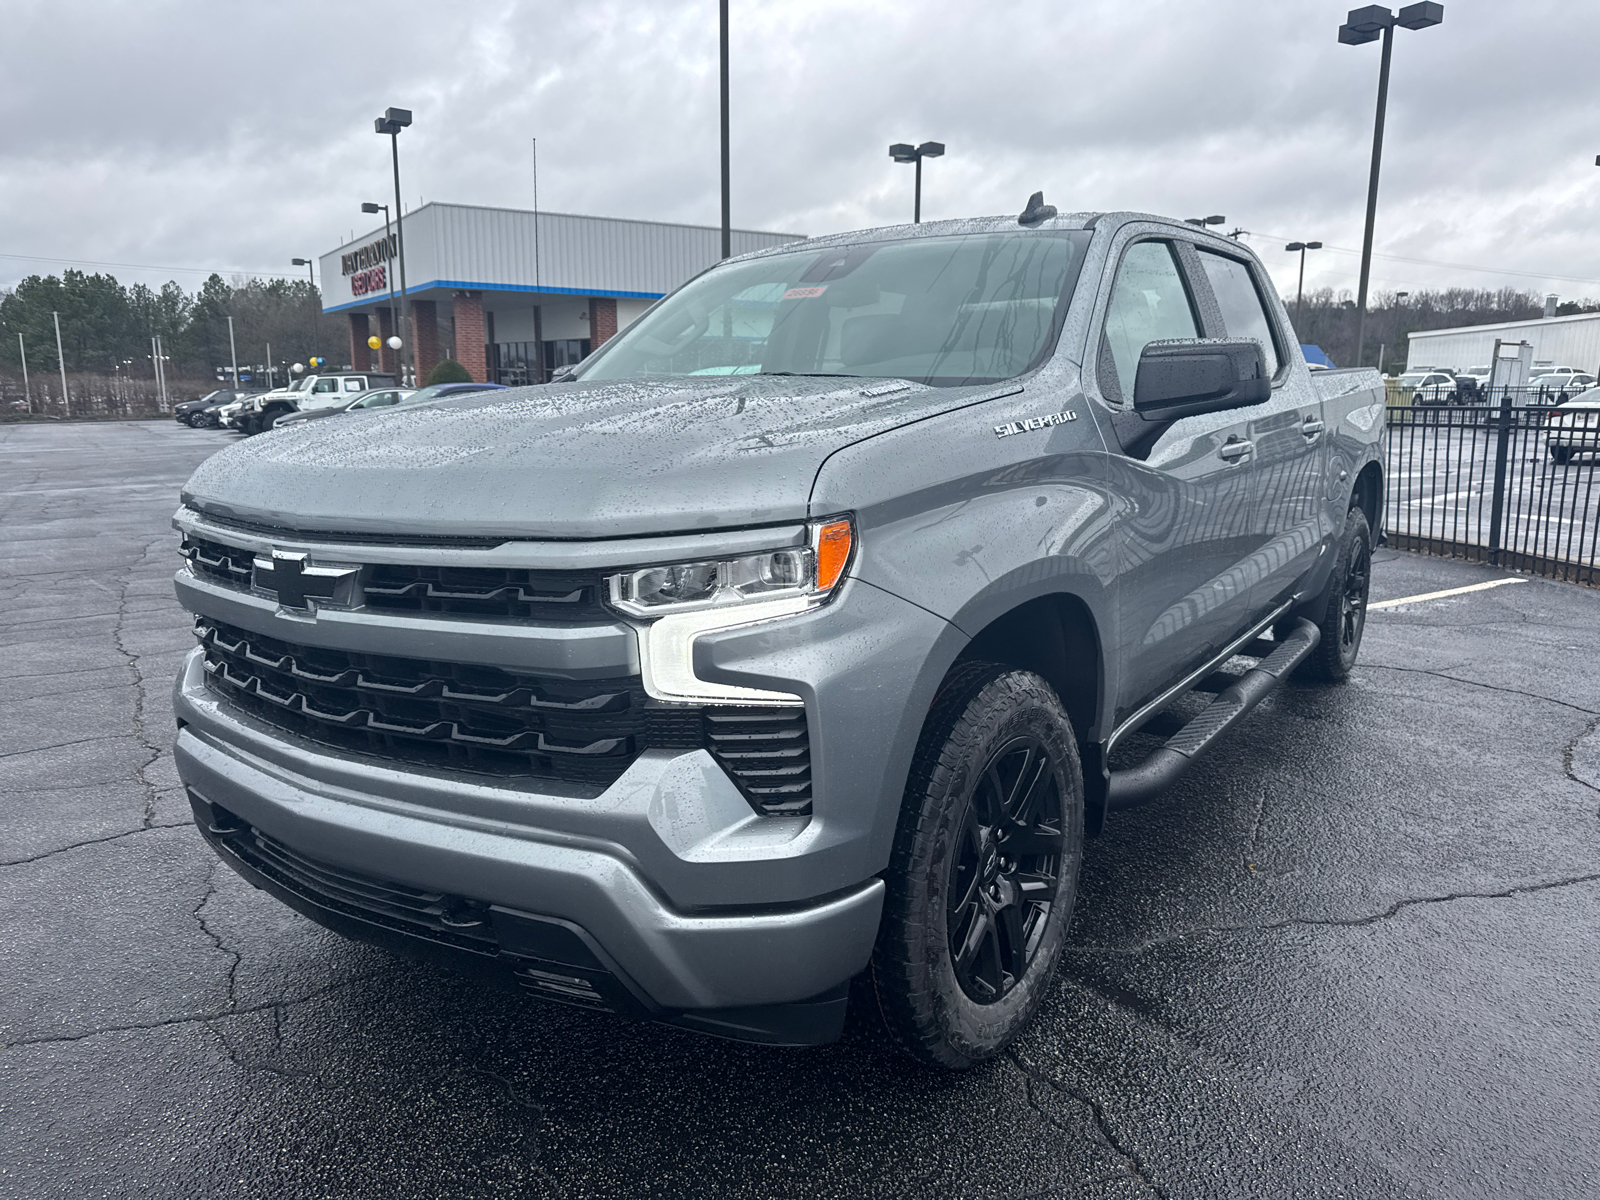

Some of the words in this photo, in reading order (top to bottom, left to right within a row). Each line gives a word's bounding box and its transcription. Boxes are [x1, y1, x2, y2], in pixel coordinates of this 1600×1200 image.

[351, 271, 367, 296] USED
[367, 265, 386, 292] CARS
[993, 409, 1077, 439] SILVERADO
